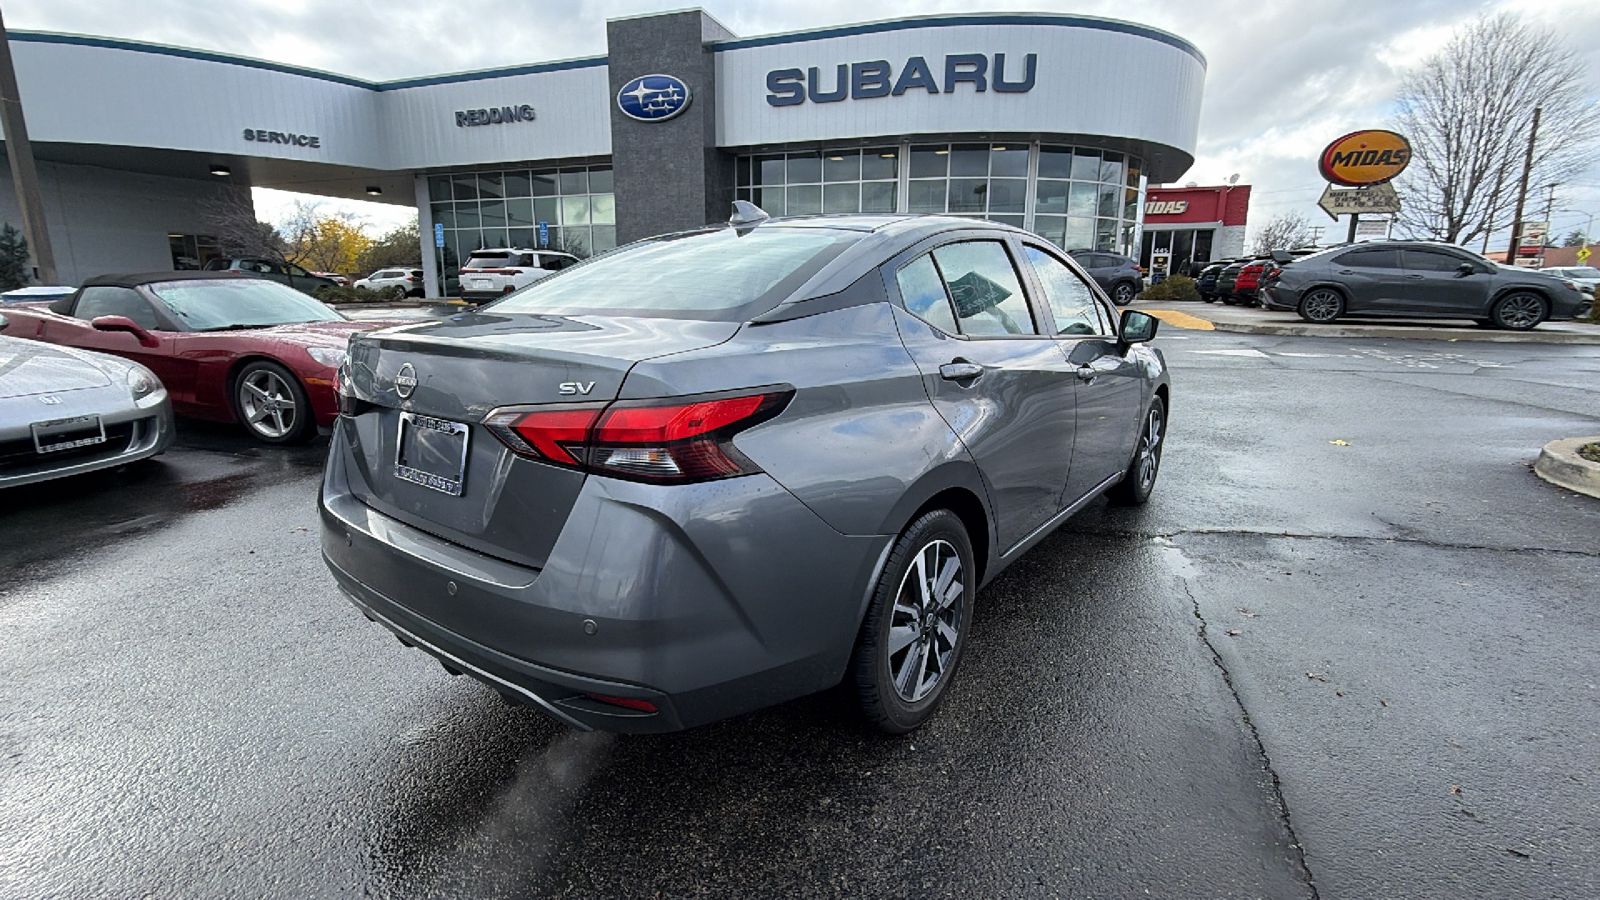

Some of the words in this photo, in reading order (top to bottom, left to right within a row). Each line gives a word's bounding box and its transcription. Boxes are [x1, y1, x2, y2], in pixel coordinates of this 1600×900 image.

[766, 53, 1038, 107] SUBARU
[455, 104, 535, 127] REDDING
[243, 128, 320, 148] SERVICE
[1331, 143, 1409, 168] MIDAS
[1145, 198, 1188, 214] IDAS
[559, 381, 596, 395] SV
